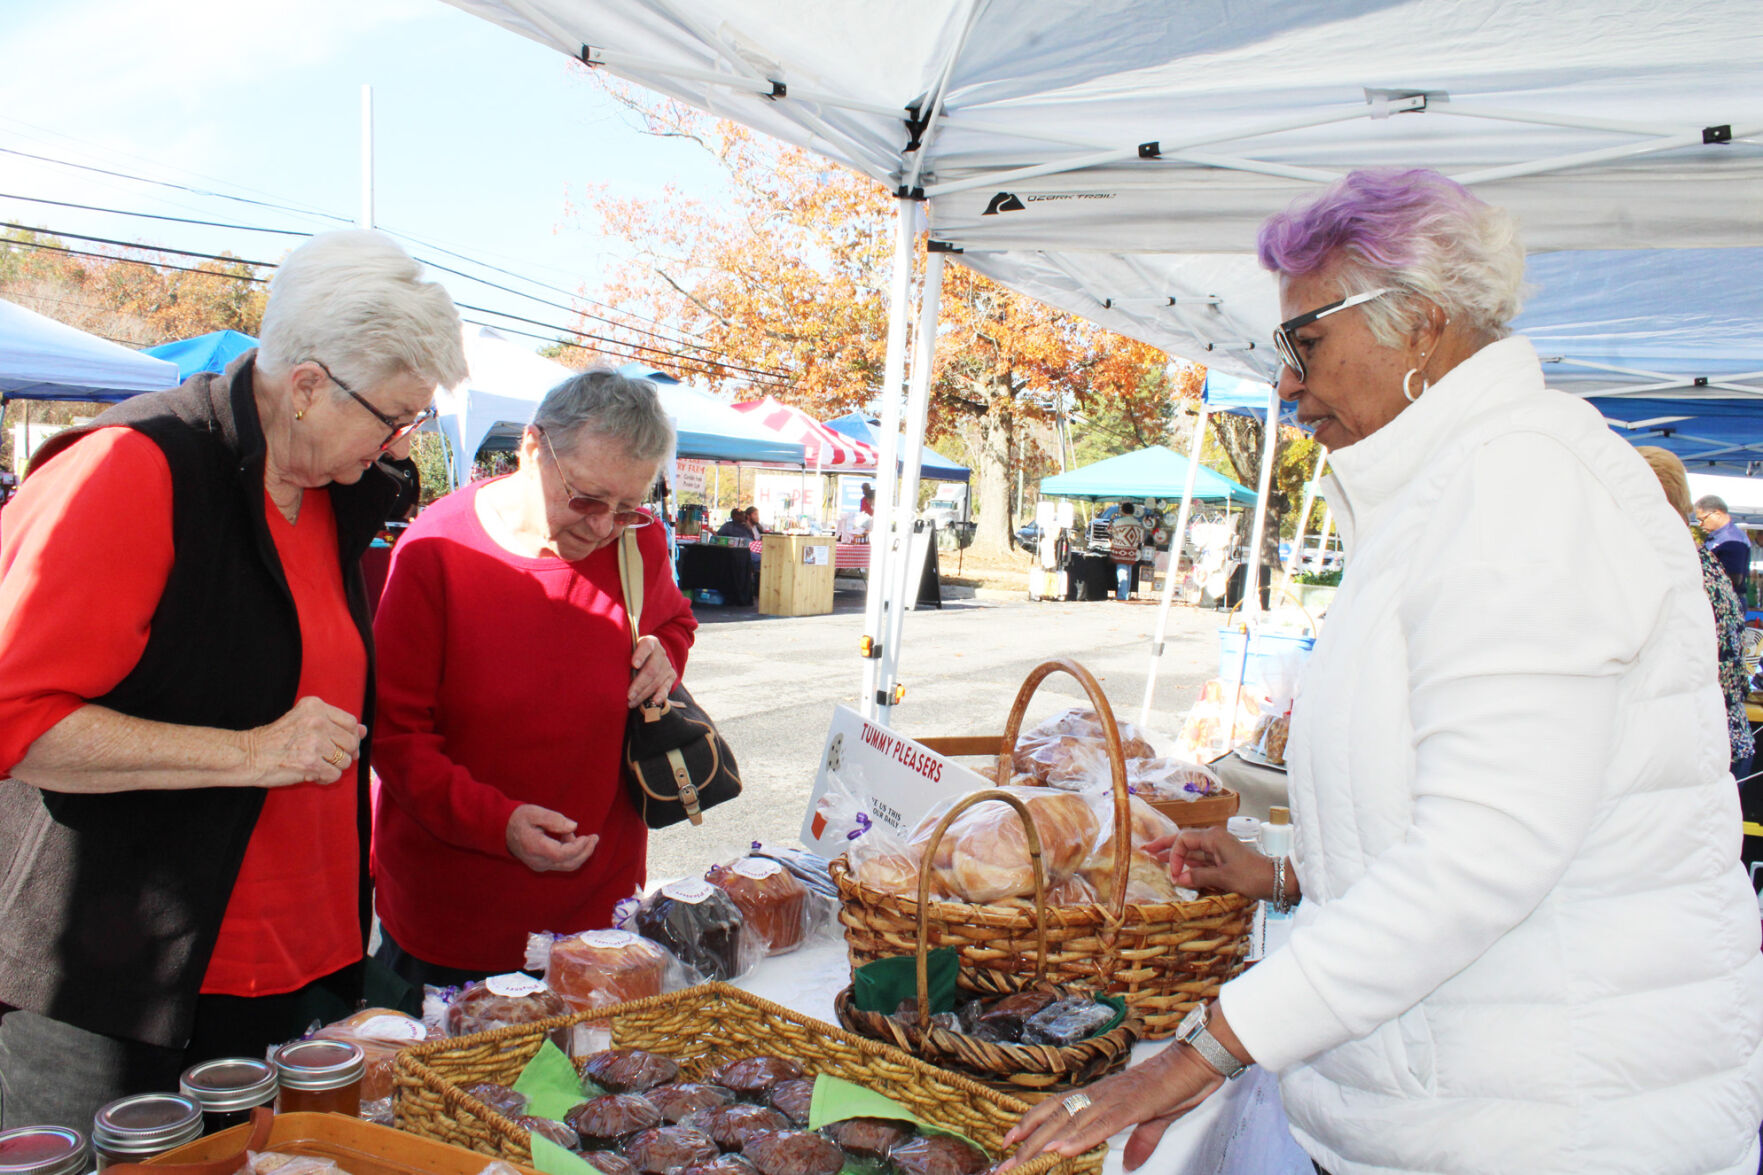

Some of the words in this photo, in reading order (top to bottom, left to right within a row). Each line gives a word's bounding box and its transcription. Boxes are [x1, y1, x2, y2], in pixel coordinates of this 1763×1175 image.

[860, 723, 894, 755] TUMMY
[892, 741, 943, 783] PLEASERS
[872, 807, 884, 819] OUR
[884, 814, 899, 829] DAILY
[888, 807, 901, 821] THIS
